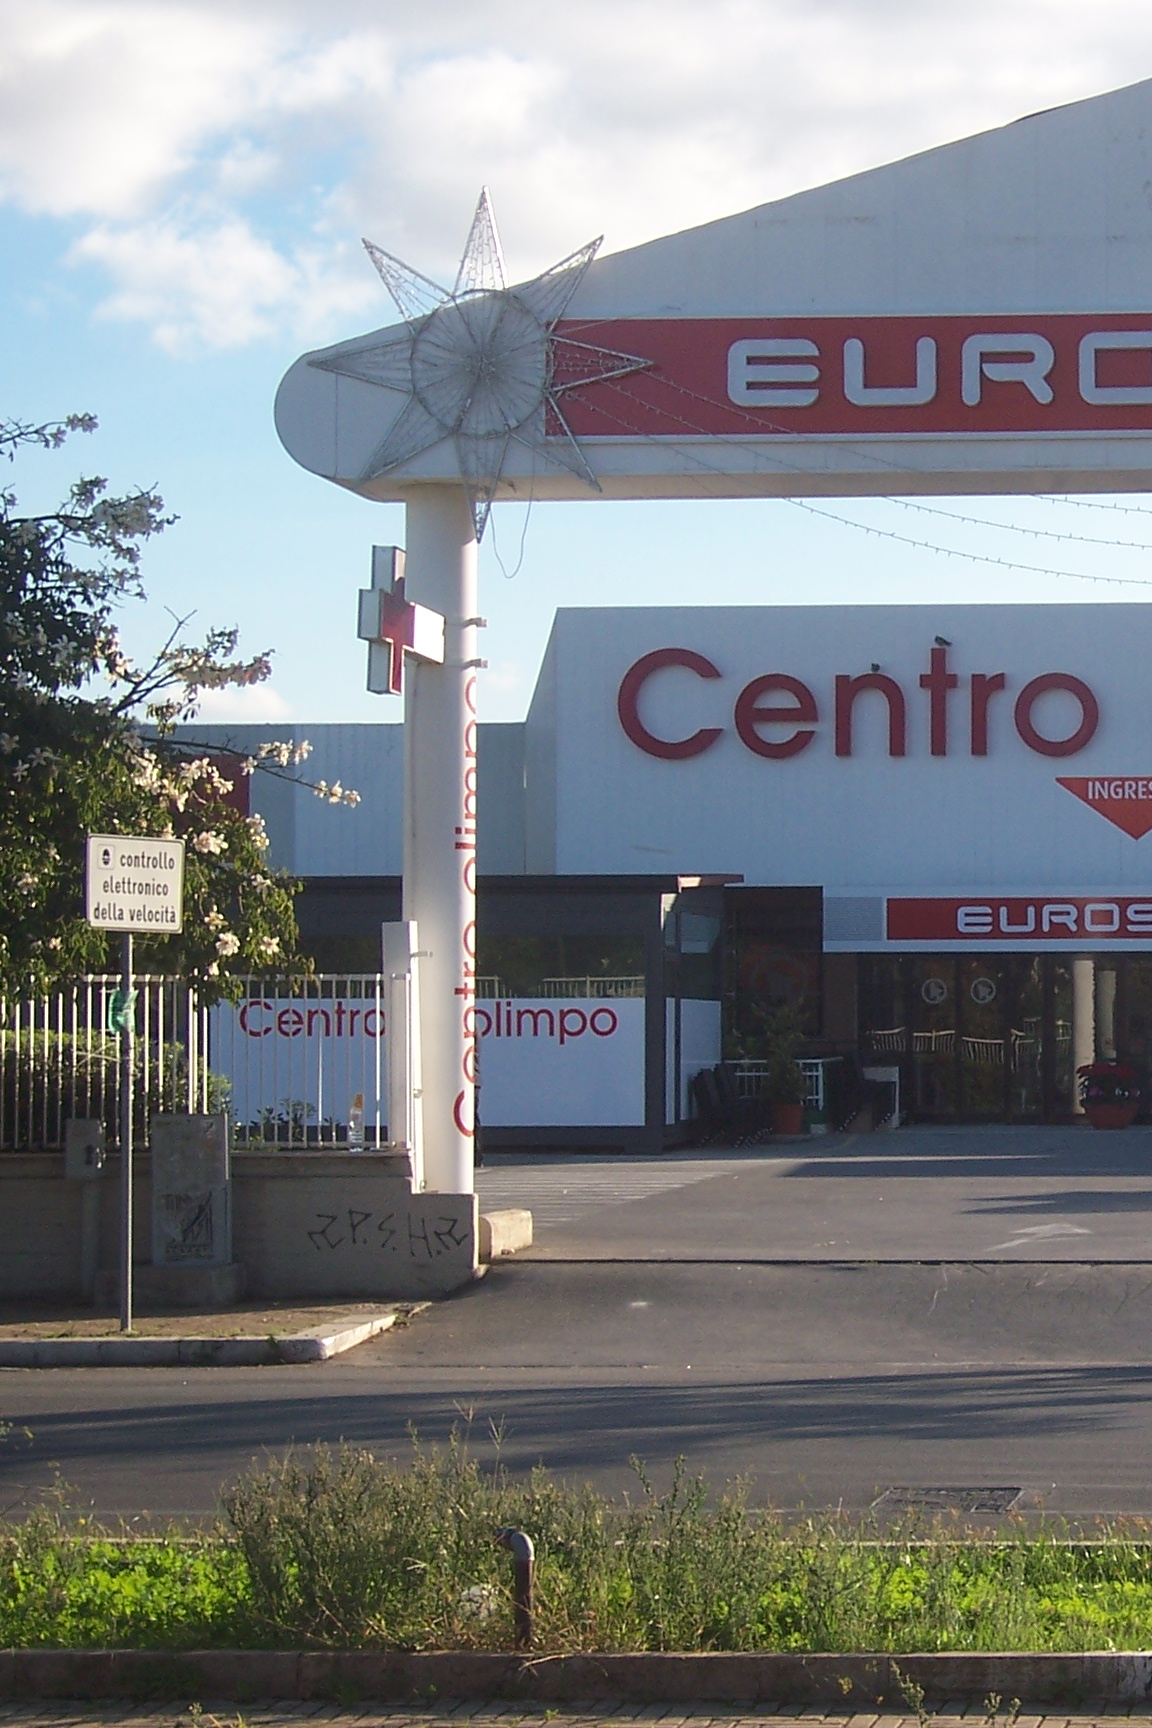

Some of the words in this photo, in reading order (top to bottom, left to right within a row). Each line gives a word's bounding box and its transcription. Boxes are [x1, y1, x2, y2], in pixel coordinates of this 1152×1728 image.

[617, 646, 1097, 759] Centro
[119, 850, 175, 870] controllo
[102, 875, 169, 896] elettronico
[93, 901, 125, 921] della
[129, 904, 177, 924] velocità
[239, 999, 387, 1040] Centro
